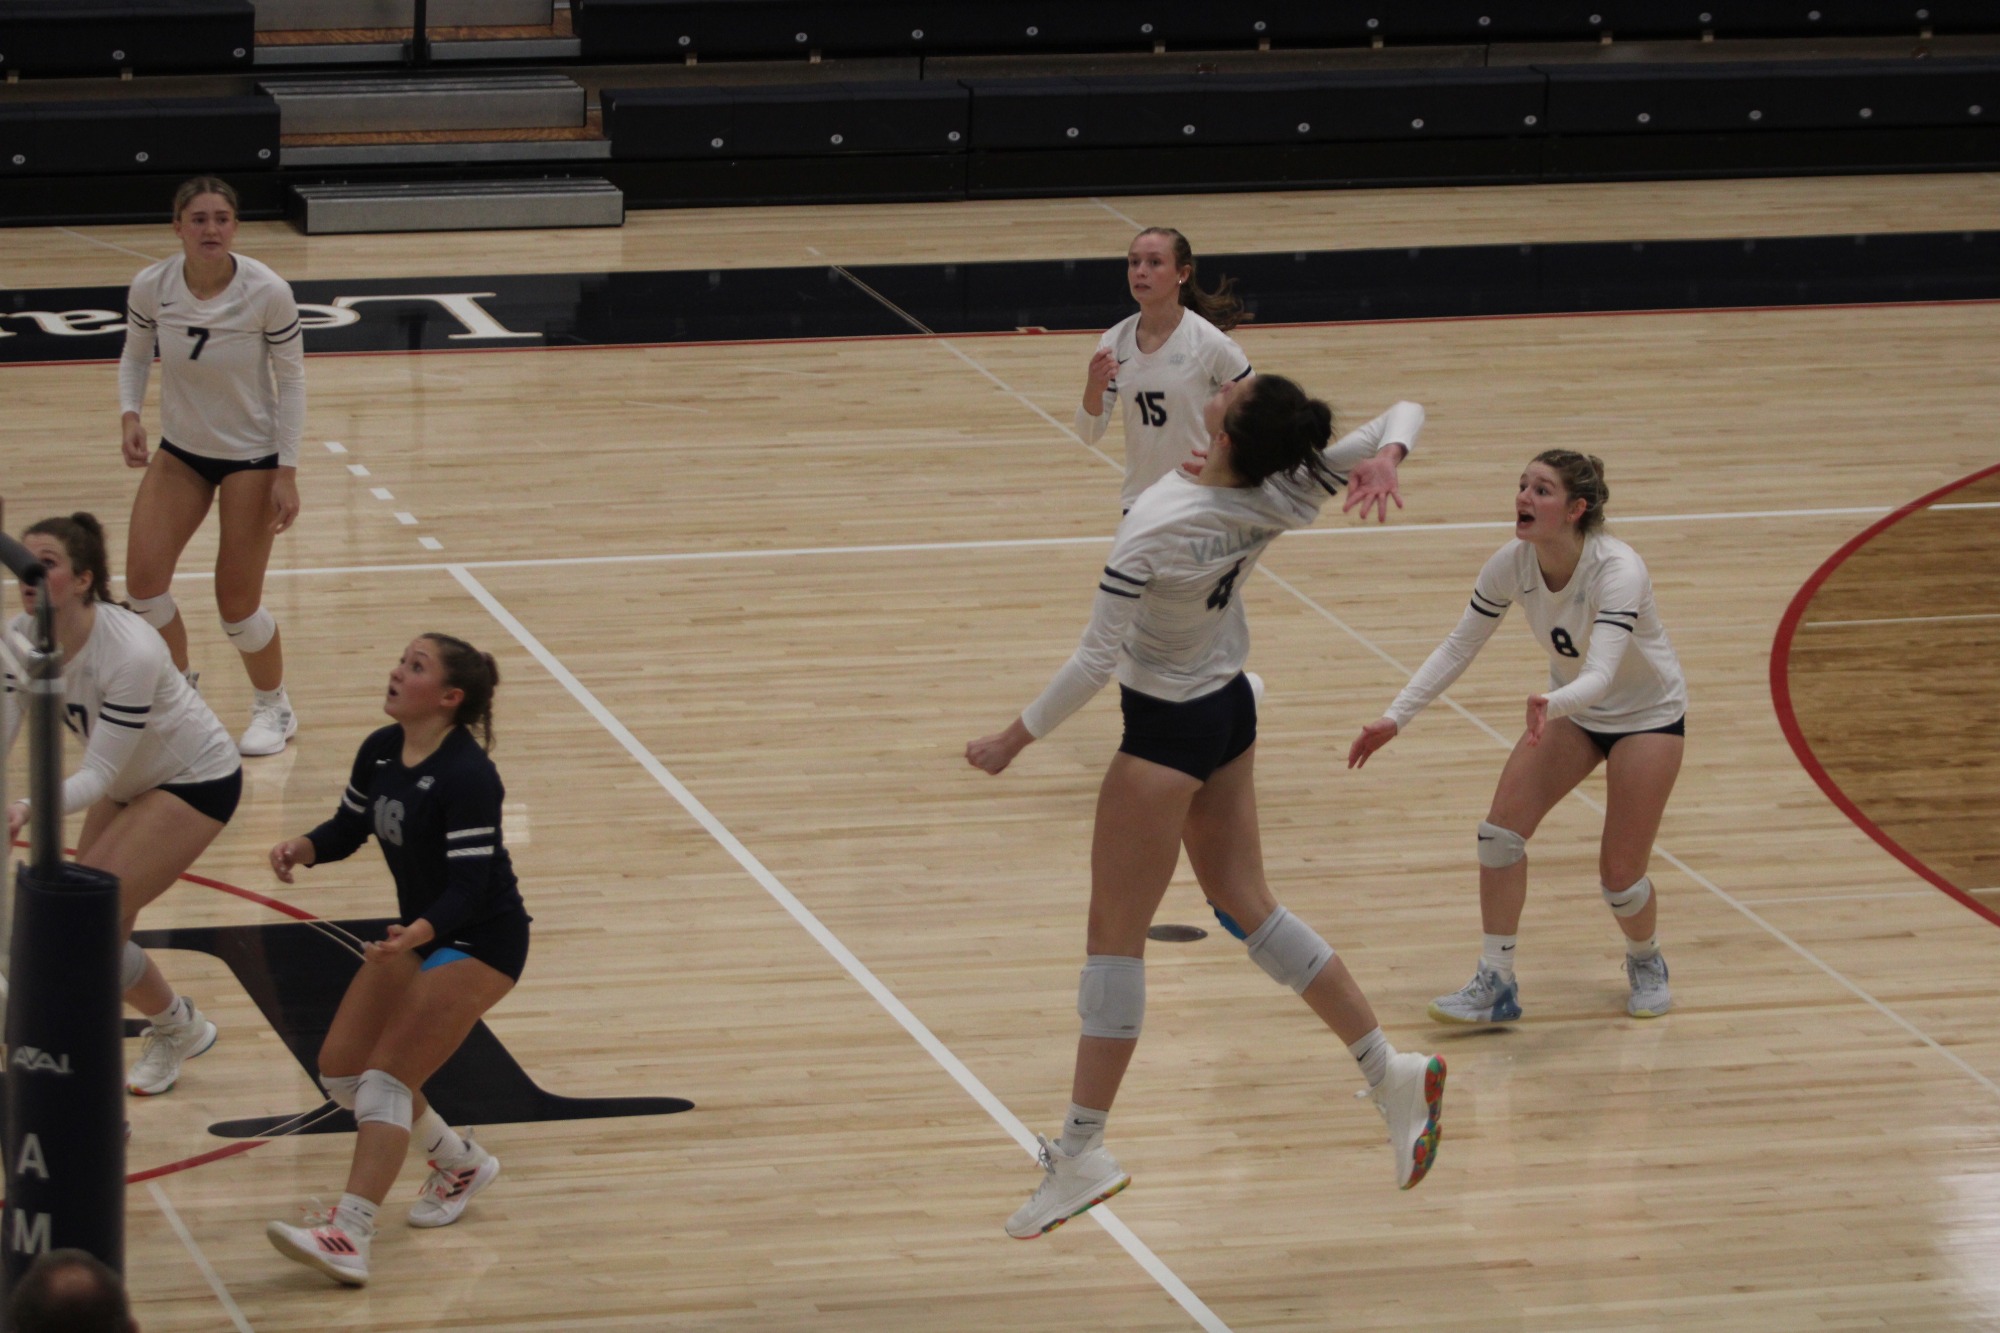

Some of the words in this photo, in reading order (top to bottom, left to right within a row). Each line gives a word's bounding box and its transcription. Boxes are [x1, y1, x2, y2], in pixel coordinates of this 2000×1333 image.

[188, 326, 210, 360] 7
[1135, 391, 1167, 427] 15
[1206, 556, 1247, 611] 4
[1551, 627, 1579, 658] 8
[373, 794, 405, 847] 16
